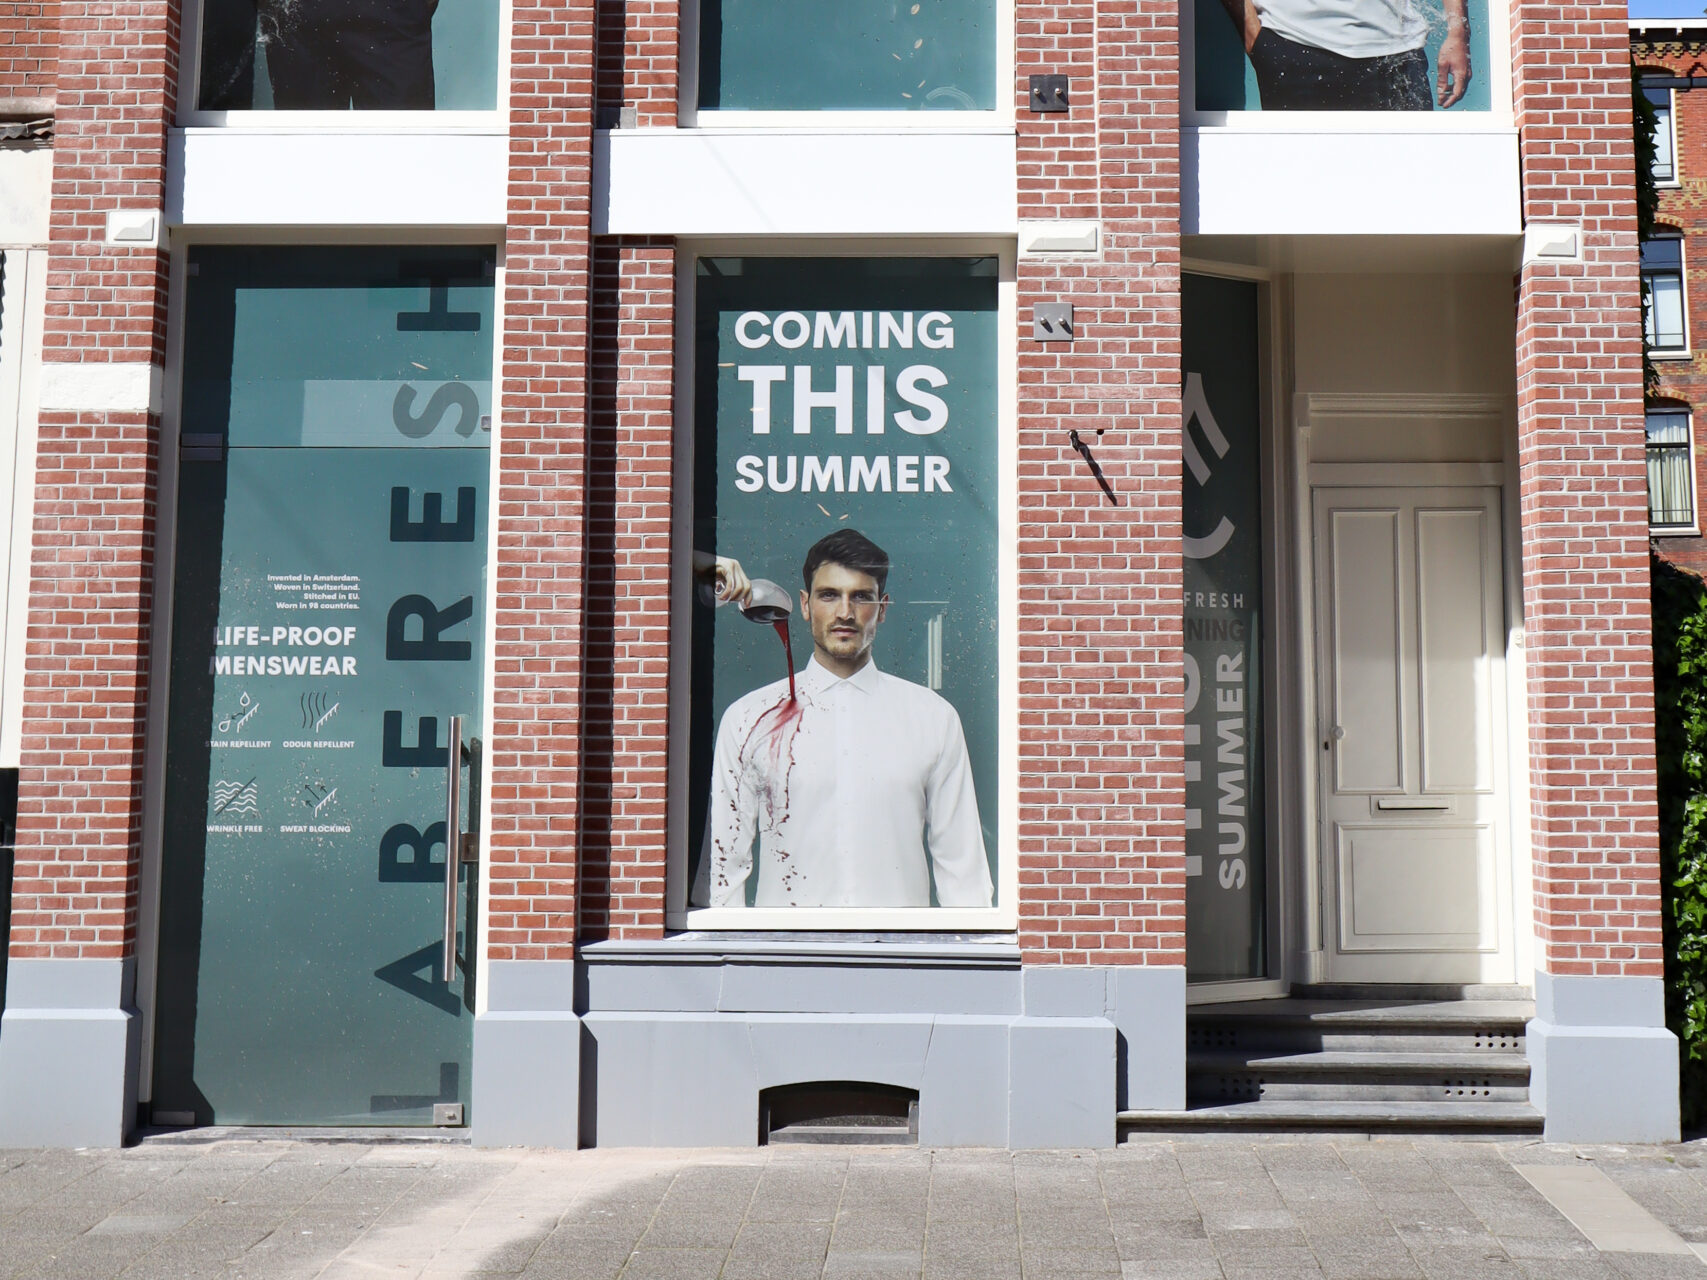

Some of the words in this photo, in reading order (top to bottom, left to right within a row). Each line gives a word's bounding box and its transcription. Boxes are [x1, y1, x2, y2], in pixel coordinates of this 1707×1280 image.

[734, 311, 954, 349] COMING
[737, 364, 949, 435] THIS
[734, 455, 954, 493] SUMMER
[267, 574, 302, 582] Invented
[303, 574, 312, 582] in
[313, 574, 361, 582] Amsterdam.
[274, 583, 302, 591] Woven
[303, 583, 311, 591] in
[312, 583, 361, 591] Switzerland.
[304, 592, 337, 600] Stitched
[338, 592, 347, 600] in
[276, 602, 298, 610] Worn
[299, 602, 308, 610] in
[308, 602, 319, 610] 98
[320, 602, 360, 610] countries.
[213, 626, 357, 646] LIFE-PROOF
[209, 656, 358, 676] MENSWEAR
[370, 260, 482, 1114] LABFRESH
[313, 741, 355, 749] REPELLENT
[1216, 651, 1247, 890] SUMMER
[206, 825, 243, 833] WRINKLE
[244, 825, 263, 833] FREE
[280, 825, 308, 833] SWEAT
[309, 825, 351, 833] BLOCKING
